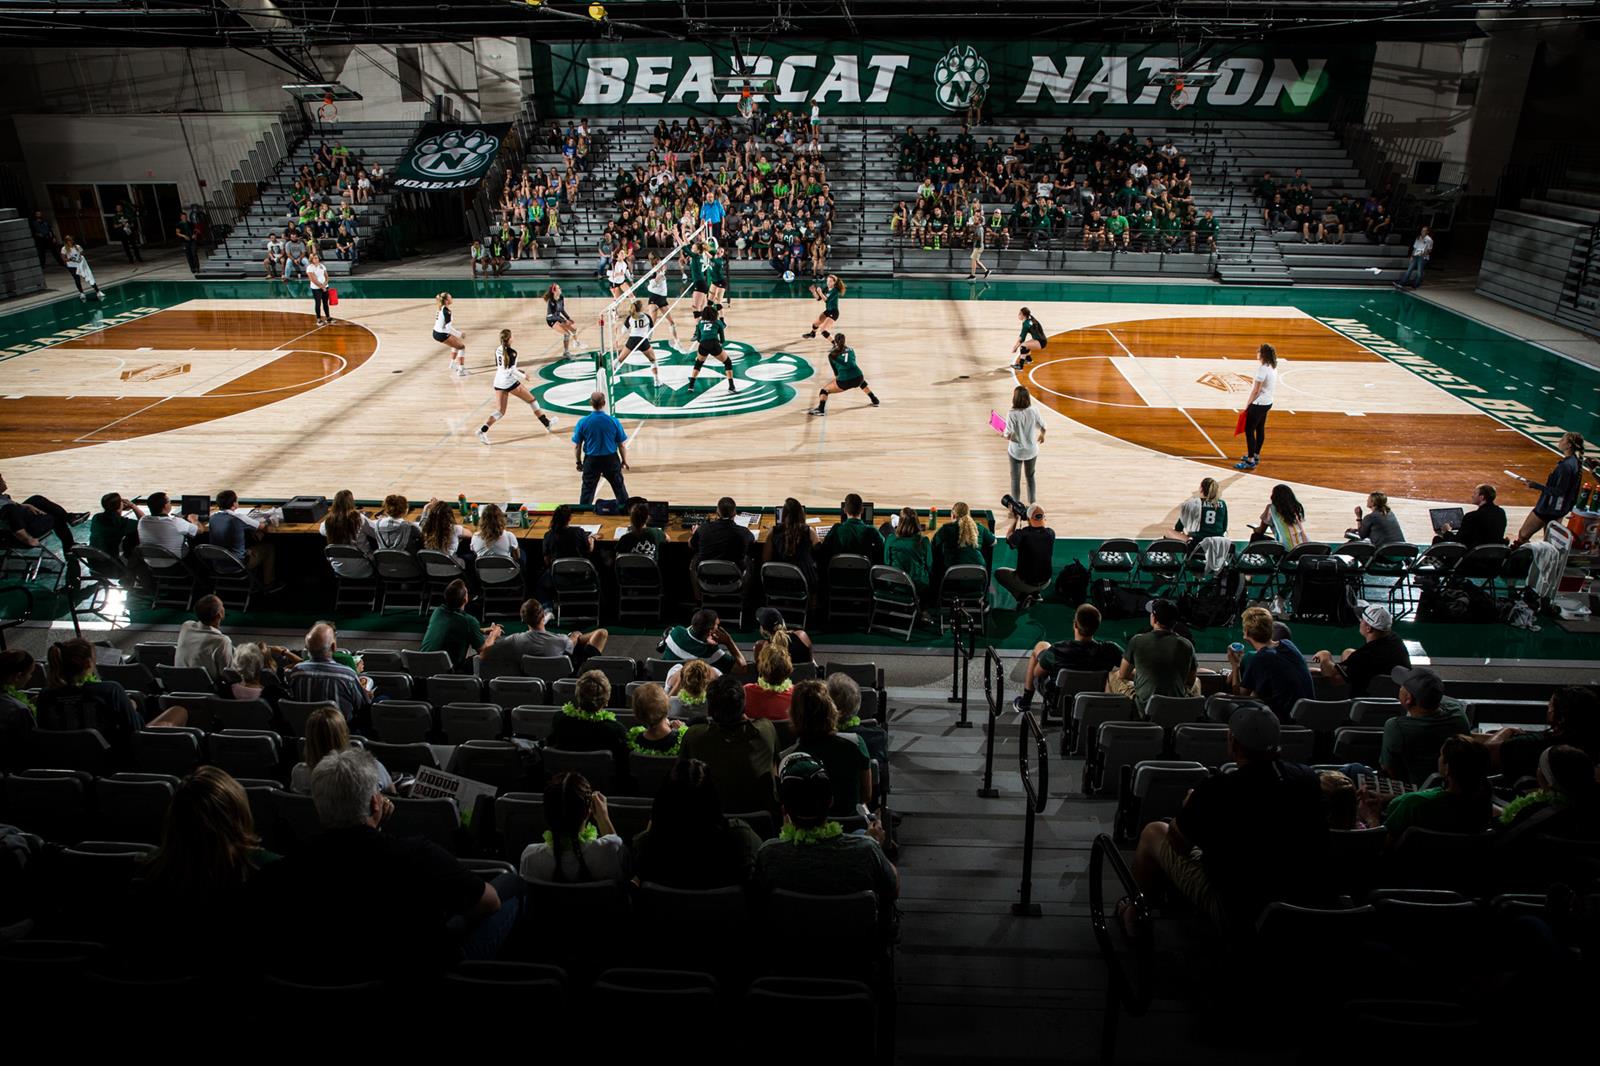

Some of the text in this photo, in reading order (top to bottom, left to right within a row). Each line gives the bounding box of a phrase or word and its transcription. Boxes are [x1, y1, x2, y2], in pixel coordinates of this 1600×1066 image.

[578, 55, 910, 104] BEARCAT
[946, 81, 972, 102] N
[424, 153, 471, 169] N
[634, 318, 644, 329] 10
[702, 323, 713, 331] 12
[1316, 316, 1489, 394] NORTHWEST
[1204, 510, 1216, 524] 8
